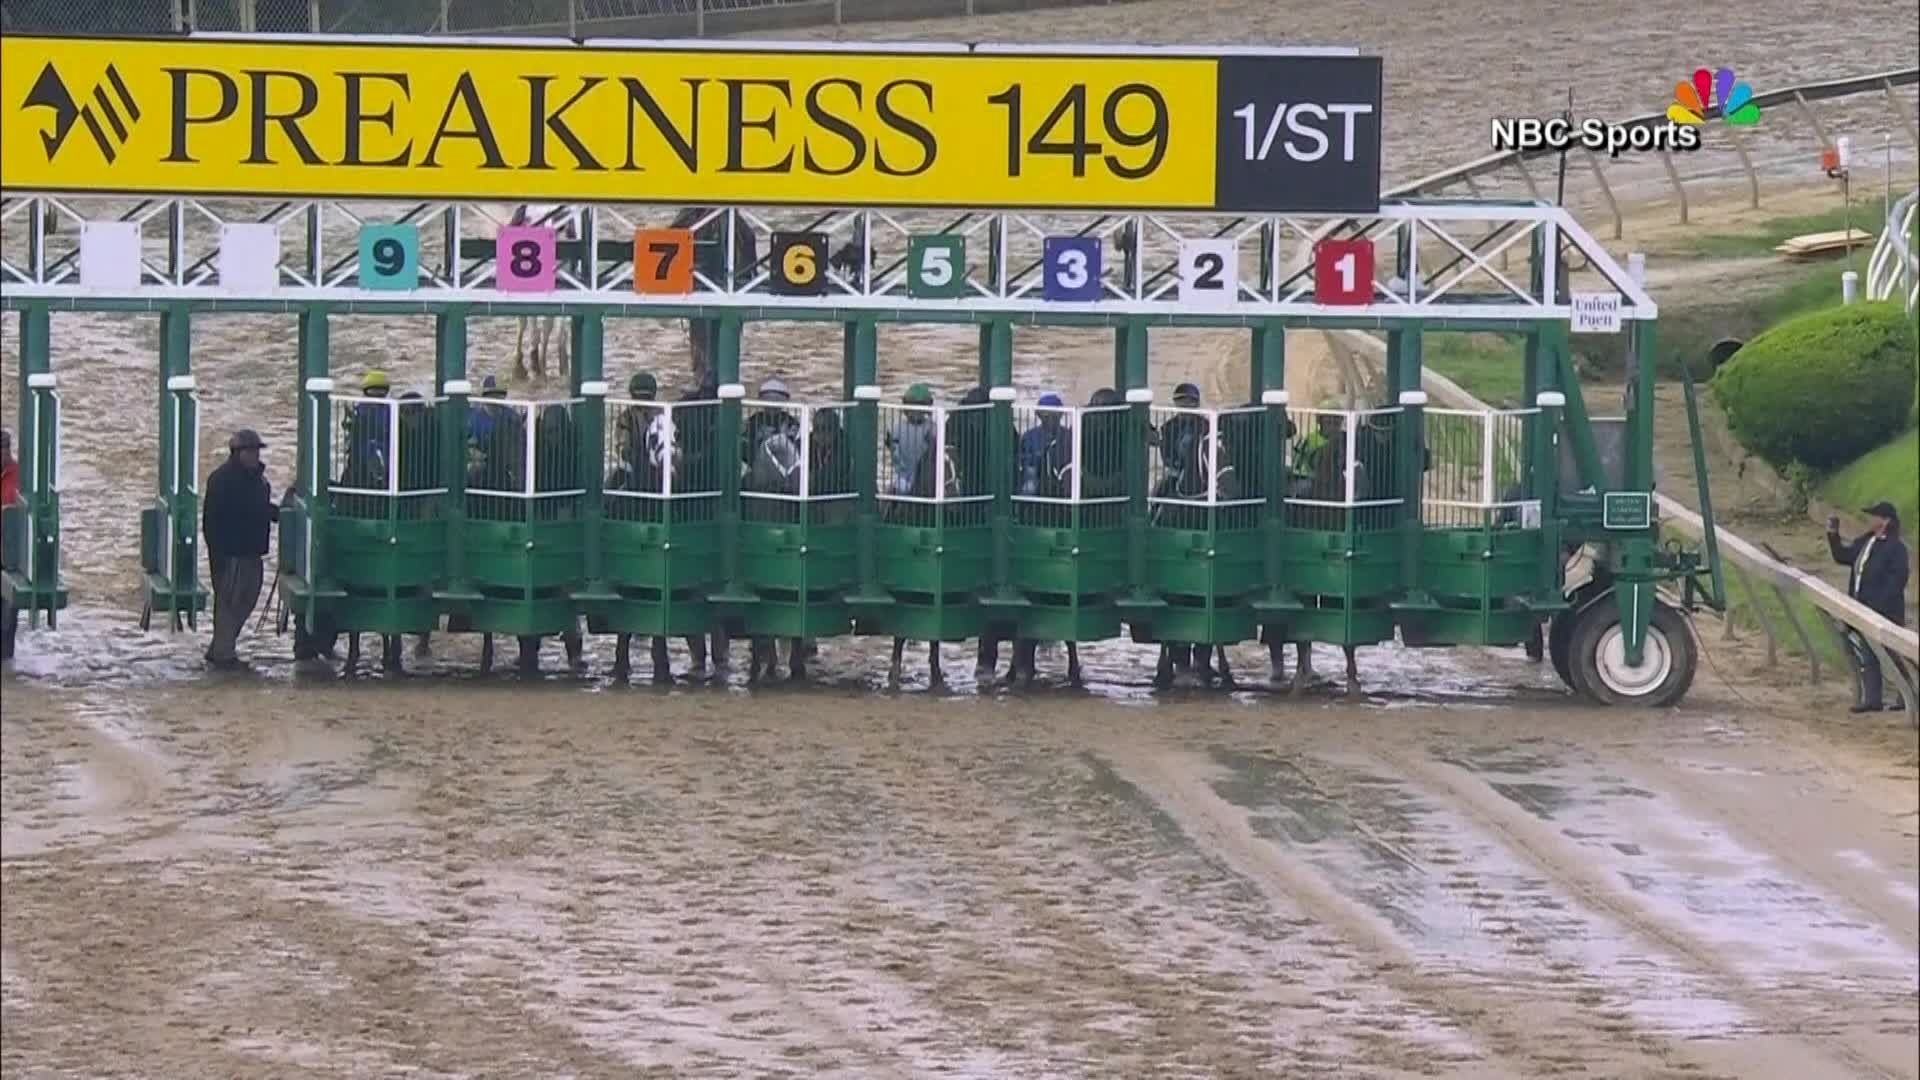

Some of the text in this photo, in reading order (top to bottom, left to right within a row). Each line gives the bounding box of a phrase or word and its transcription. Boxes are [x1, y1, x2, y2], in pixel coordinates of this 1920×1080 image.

[160, 67, 1169, 180] PREAKNESS 149
[1233, 103, 1373, 162] 1/ST
[373, 239, 405, 276] 9
[511, 240, 541, 278] 8
[649, 243, 679, 280] 7
[783, 245, 816, 283] 6
[921, 248, 952, 286] 5
[1056, 250, 1088, 289] 3
[1194, 253, 1223, 289] 2
[1334, 254, 1355, 291] 1
[1575, 297, 1617, 312] United
